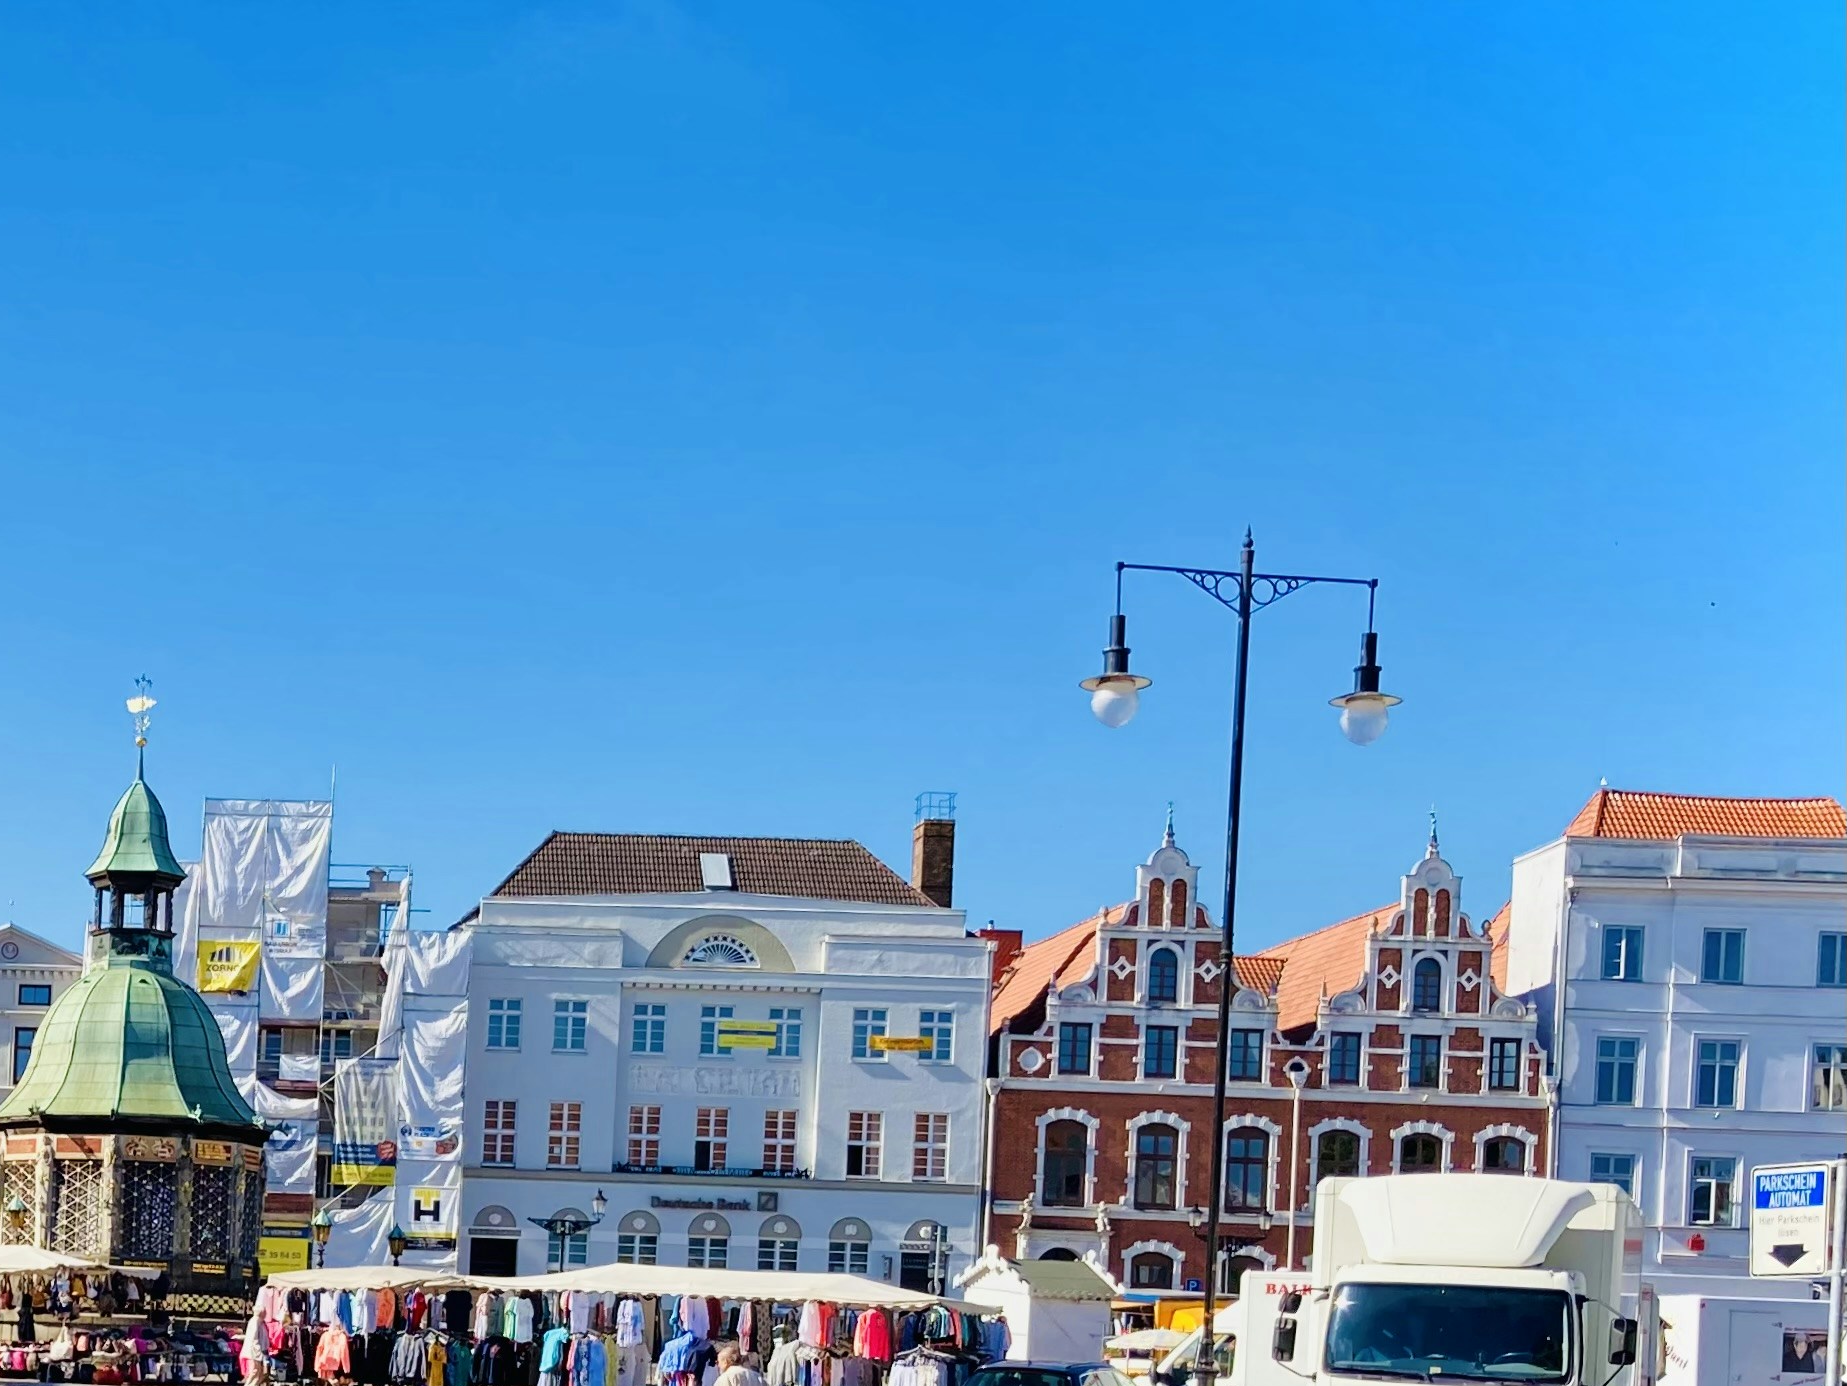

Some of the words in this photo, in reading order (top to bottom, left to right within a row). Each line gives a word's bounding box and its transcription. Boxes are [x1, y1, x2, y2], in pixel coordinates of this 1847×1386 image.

[1759, 1173, 1817, 1192] PARKSCHEIN
[651, 1196, 713, 1209] Deutsche
[717, 1198, 751, 1211] Bank
[1768, 1190, 1812, 1208] AUTOMAT
[1759, 1216, 1775, 1225] Hier
[1778, 1214, 1820, 1225] Parkschein
[1189, 1280, 1198, 1290] P
